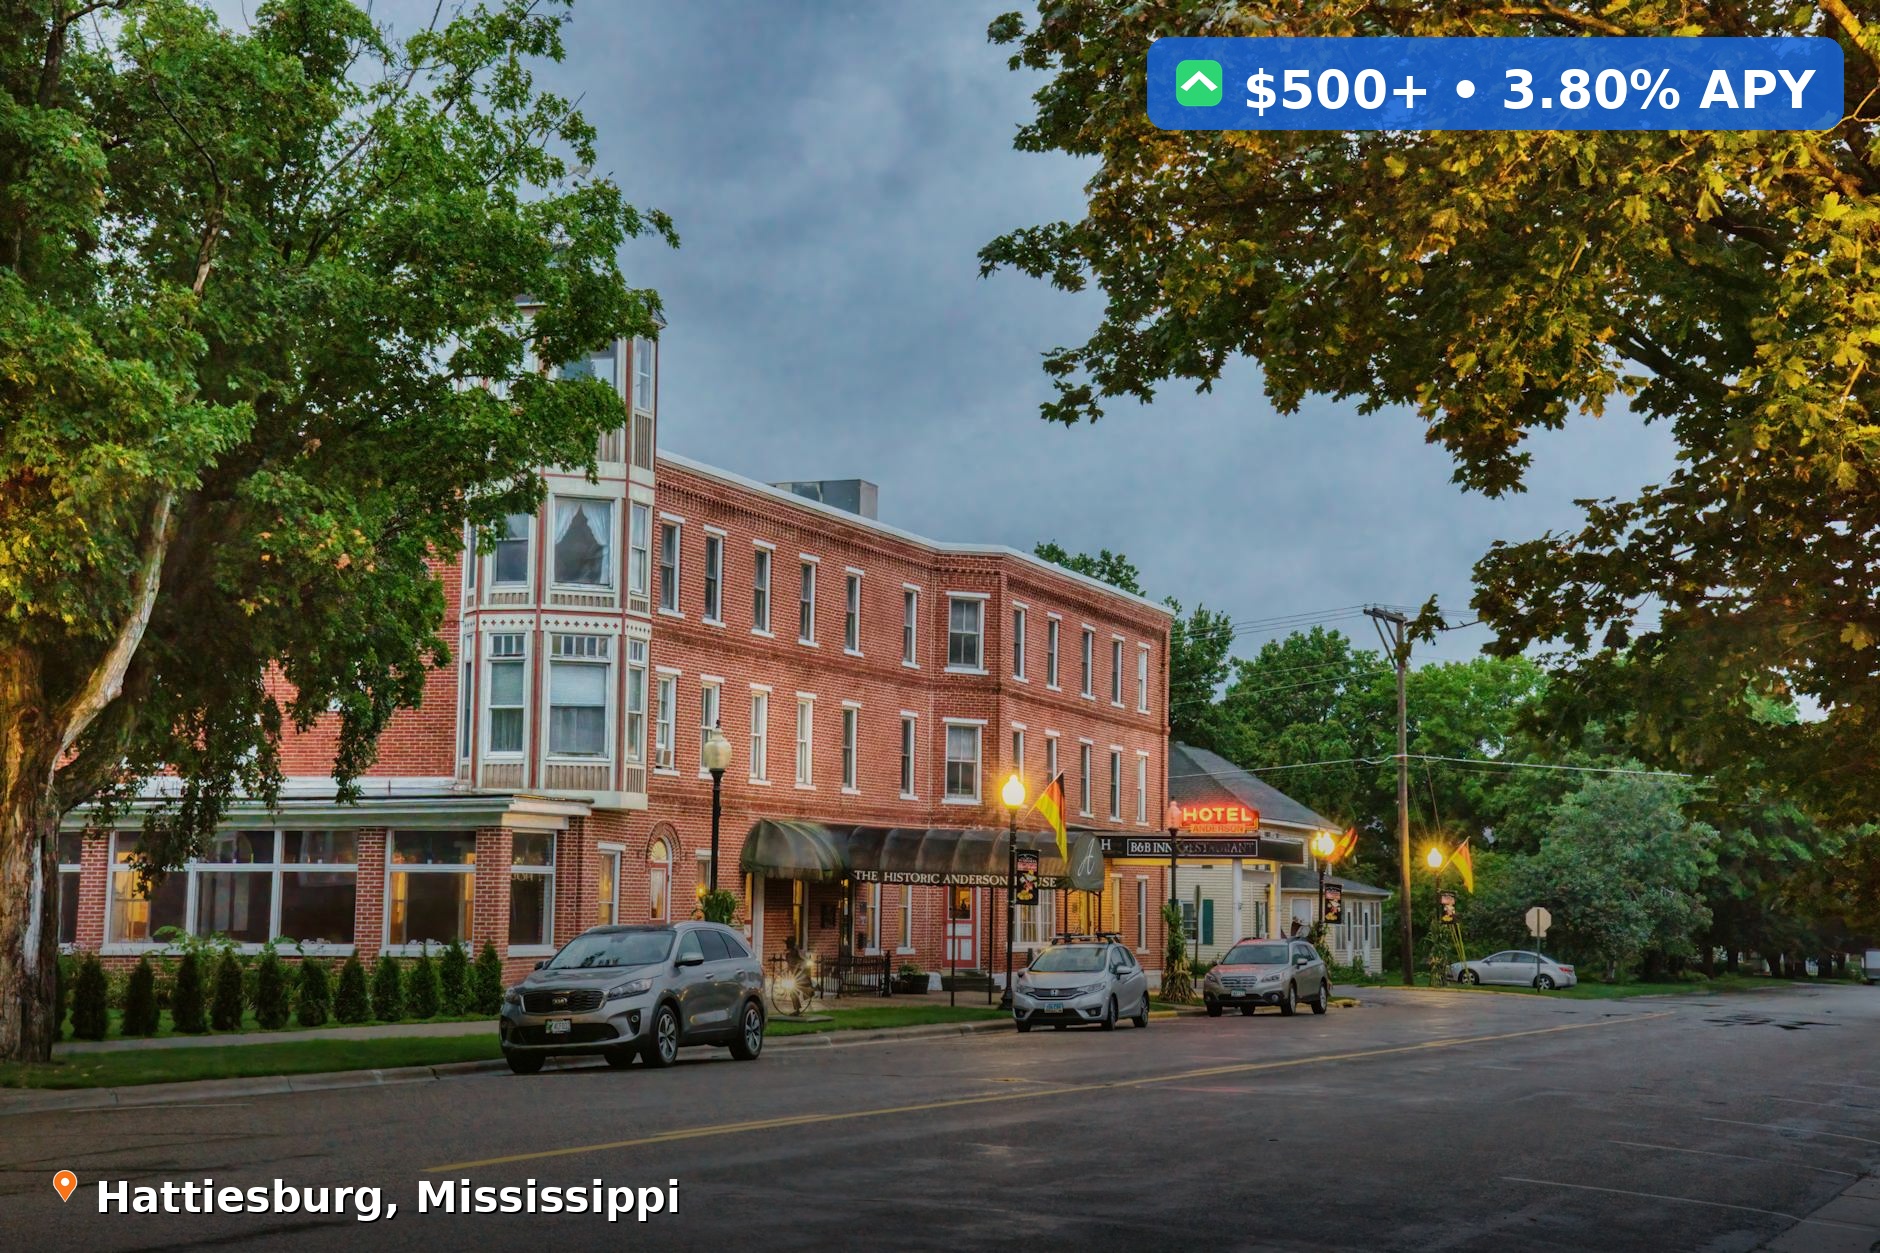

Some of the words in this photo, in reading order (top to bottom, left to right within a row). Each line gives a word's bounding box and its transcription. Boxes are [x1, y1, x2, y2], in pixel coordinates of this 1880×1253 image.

[1183, 807, 1252, 822] HOTEL
[1192, 825, 1243, 833] ANDERSON
[1130, 843, 1151, 852] B&B
[1181, 842, 1254, 854] ESTRANT
[854, 870, 878, 881] THE
[884, 872, 940, 884] HISTORIC
[943, 874, 1009, 886] ANDERSON
